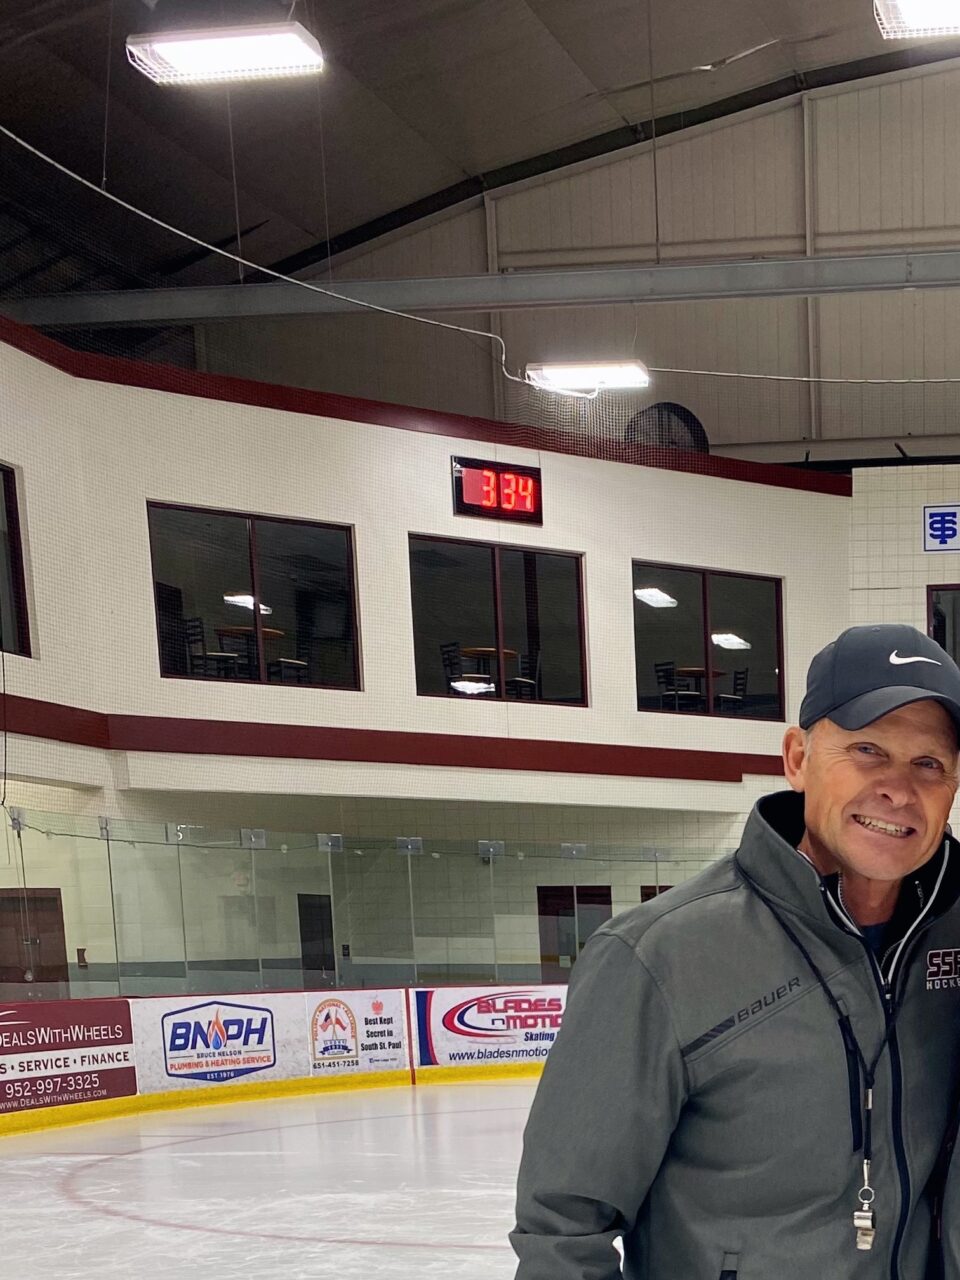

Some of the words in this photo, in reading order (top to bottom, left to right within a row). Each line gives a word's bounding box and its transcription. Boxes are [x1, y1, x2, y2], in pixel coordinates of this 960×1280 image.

[477, 998, 563, 1013] BLADES
[364, 1017, 378, 1025] Best
[379, 1016, 393, 1025] Kept
[0, 1025, 123, 1047] EALSWITHWHEELS
[366, 1030, 386, 1038] Secret
[387, 1029, 393, 1037] in
[524, 1031, 555, 1042] Skating
[361, 1041, 378, 1051] South
[388, 1040, 402, 1049] Paul
[196, 1051, 216, 1059] BRUCE
[449, 1047, 549, 1061] www.bladesnmotio
[18, 1057, 70, 1072] SERVICE
[81, 1051, 129, 1066] FINANCE
[170, 1061, 204, 1071] PLUMBING
[211, 1058, 241, 1067] HEATING
[242, 1055, 272, 1064] SERVICE
[5, 1074, 100, 1098] 952-997-3325
